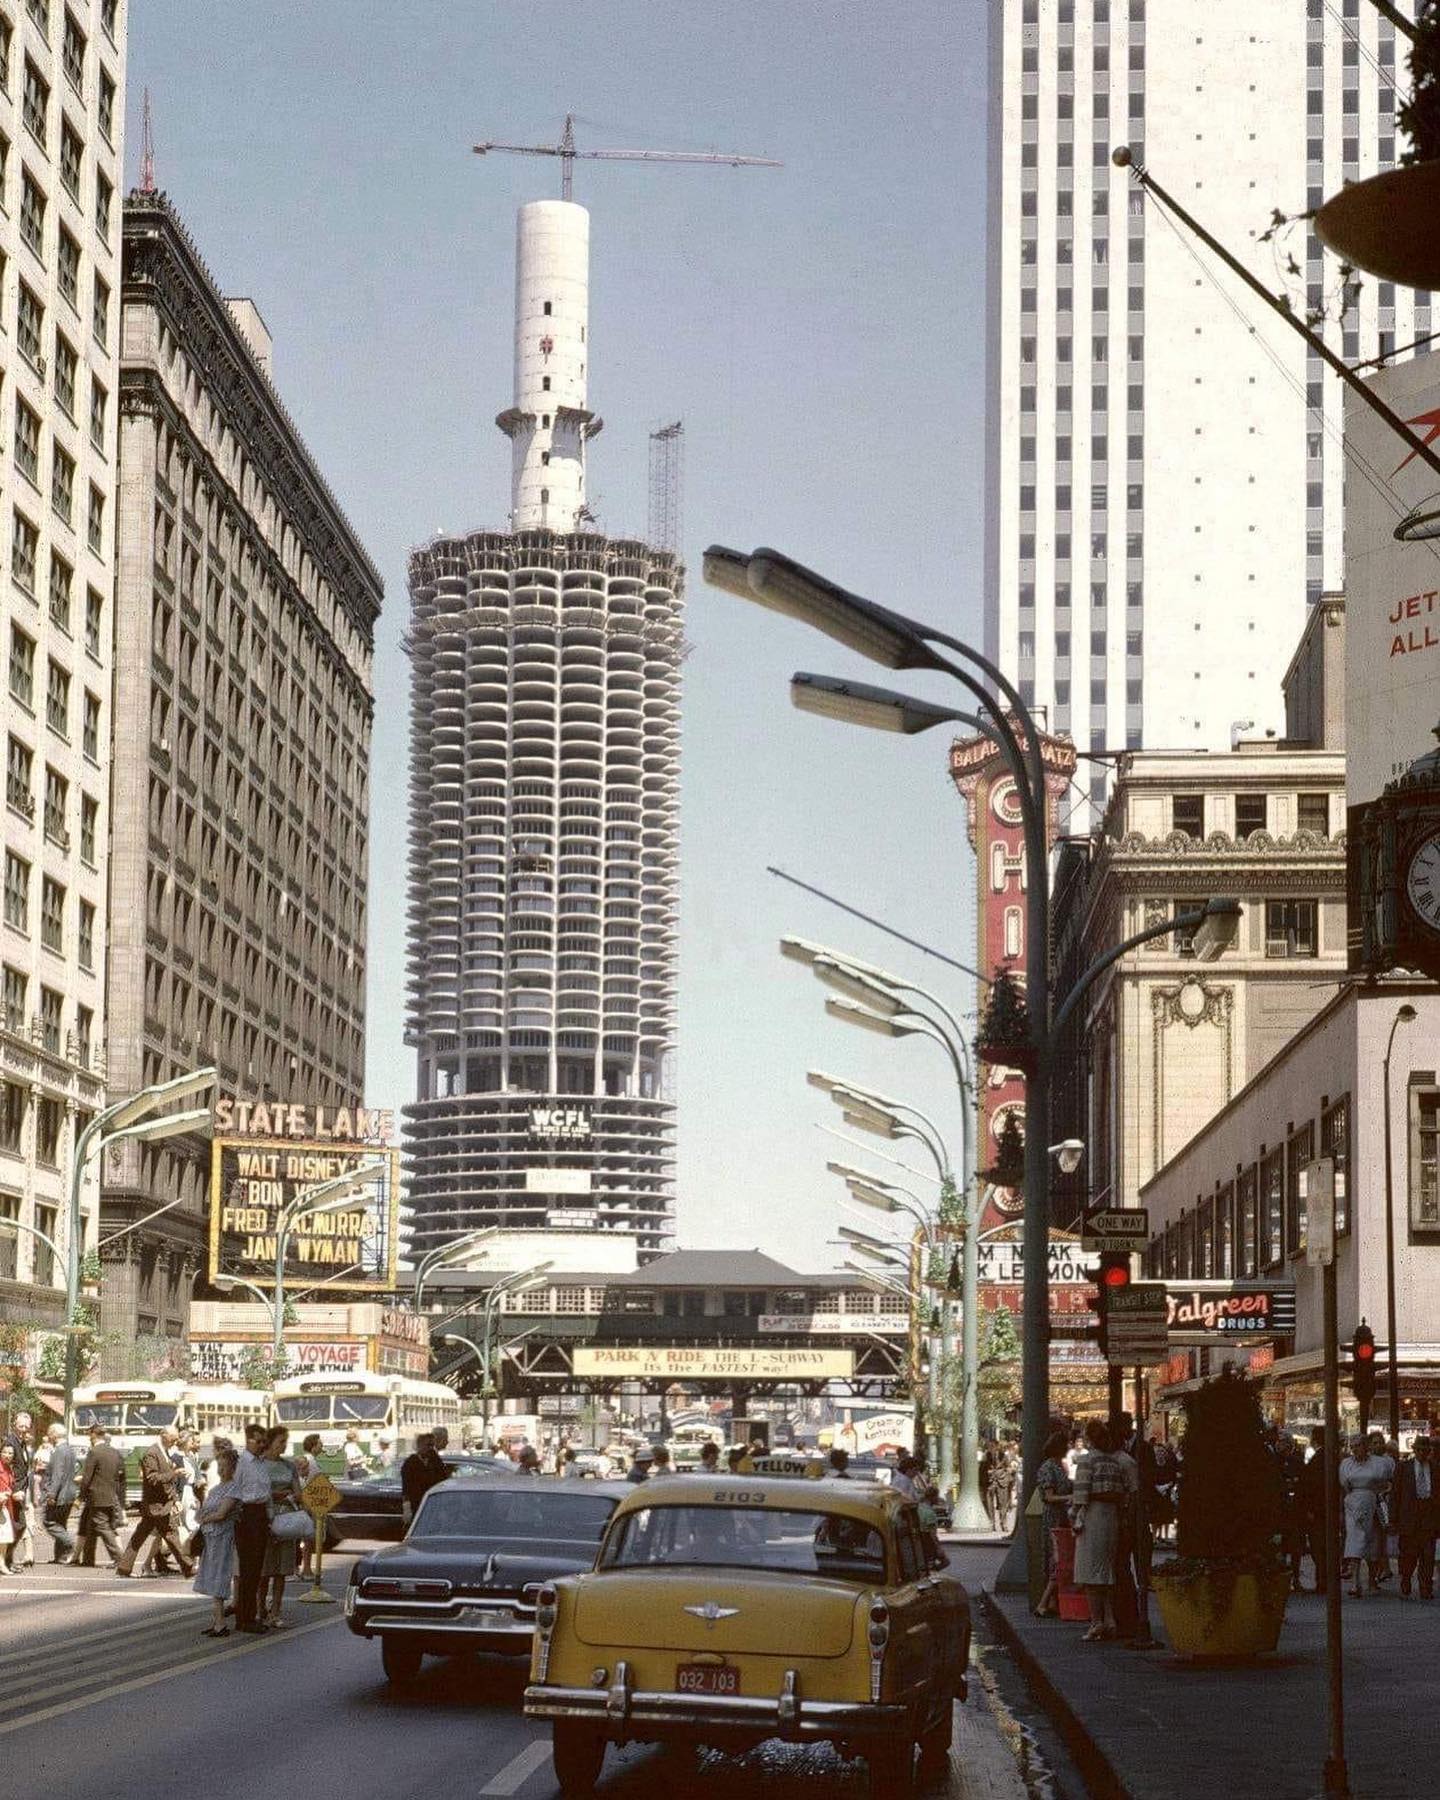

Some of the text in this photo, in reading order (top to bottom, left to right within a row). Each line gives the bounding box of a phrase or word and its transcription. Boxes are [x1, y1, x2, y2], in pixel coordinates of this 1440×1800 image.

[1389, 626, 1439, 658] ALL
[214, 1101, 395, 1140] STATE LAKE
[532, 1109, 590, 1127] WCFL
[237, 1153, 280, 1178] WALT
[222, 1208, 268, 1232] FRED
[1097, 1216, 1142, 1229] ONE WAY
[241, 1236, 359, 1263] JAN WYMAN
[1012, 1244, 1071, 1260] NAK
[999, 1263, 1088, 1280] LEMON
[1217, 1317, 1266, 1329] DRUGS
[198, 1343, 223, 1352] WALT
[297, 1345, 360, 1363] VOYAGE
[594, 1351, 640, 1361] PARK
[667, 1351, 704, 1361] RIDE
[715, 1352, 740, 1362] THE
[202, 1361, 227, 1371] FRED
[319, 1363, 354, 1373] WYMAN
[668, 1363, 693, 1372] the
[702, 1363, 757, 1373] FASTEST
[752, 1460, 806, 1473] YELLOW
[714, 1491, 767, 1503] 2103
[679, 1671, 736, 1690] 032 103
